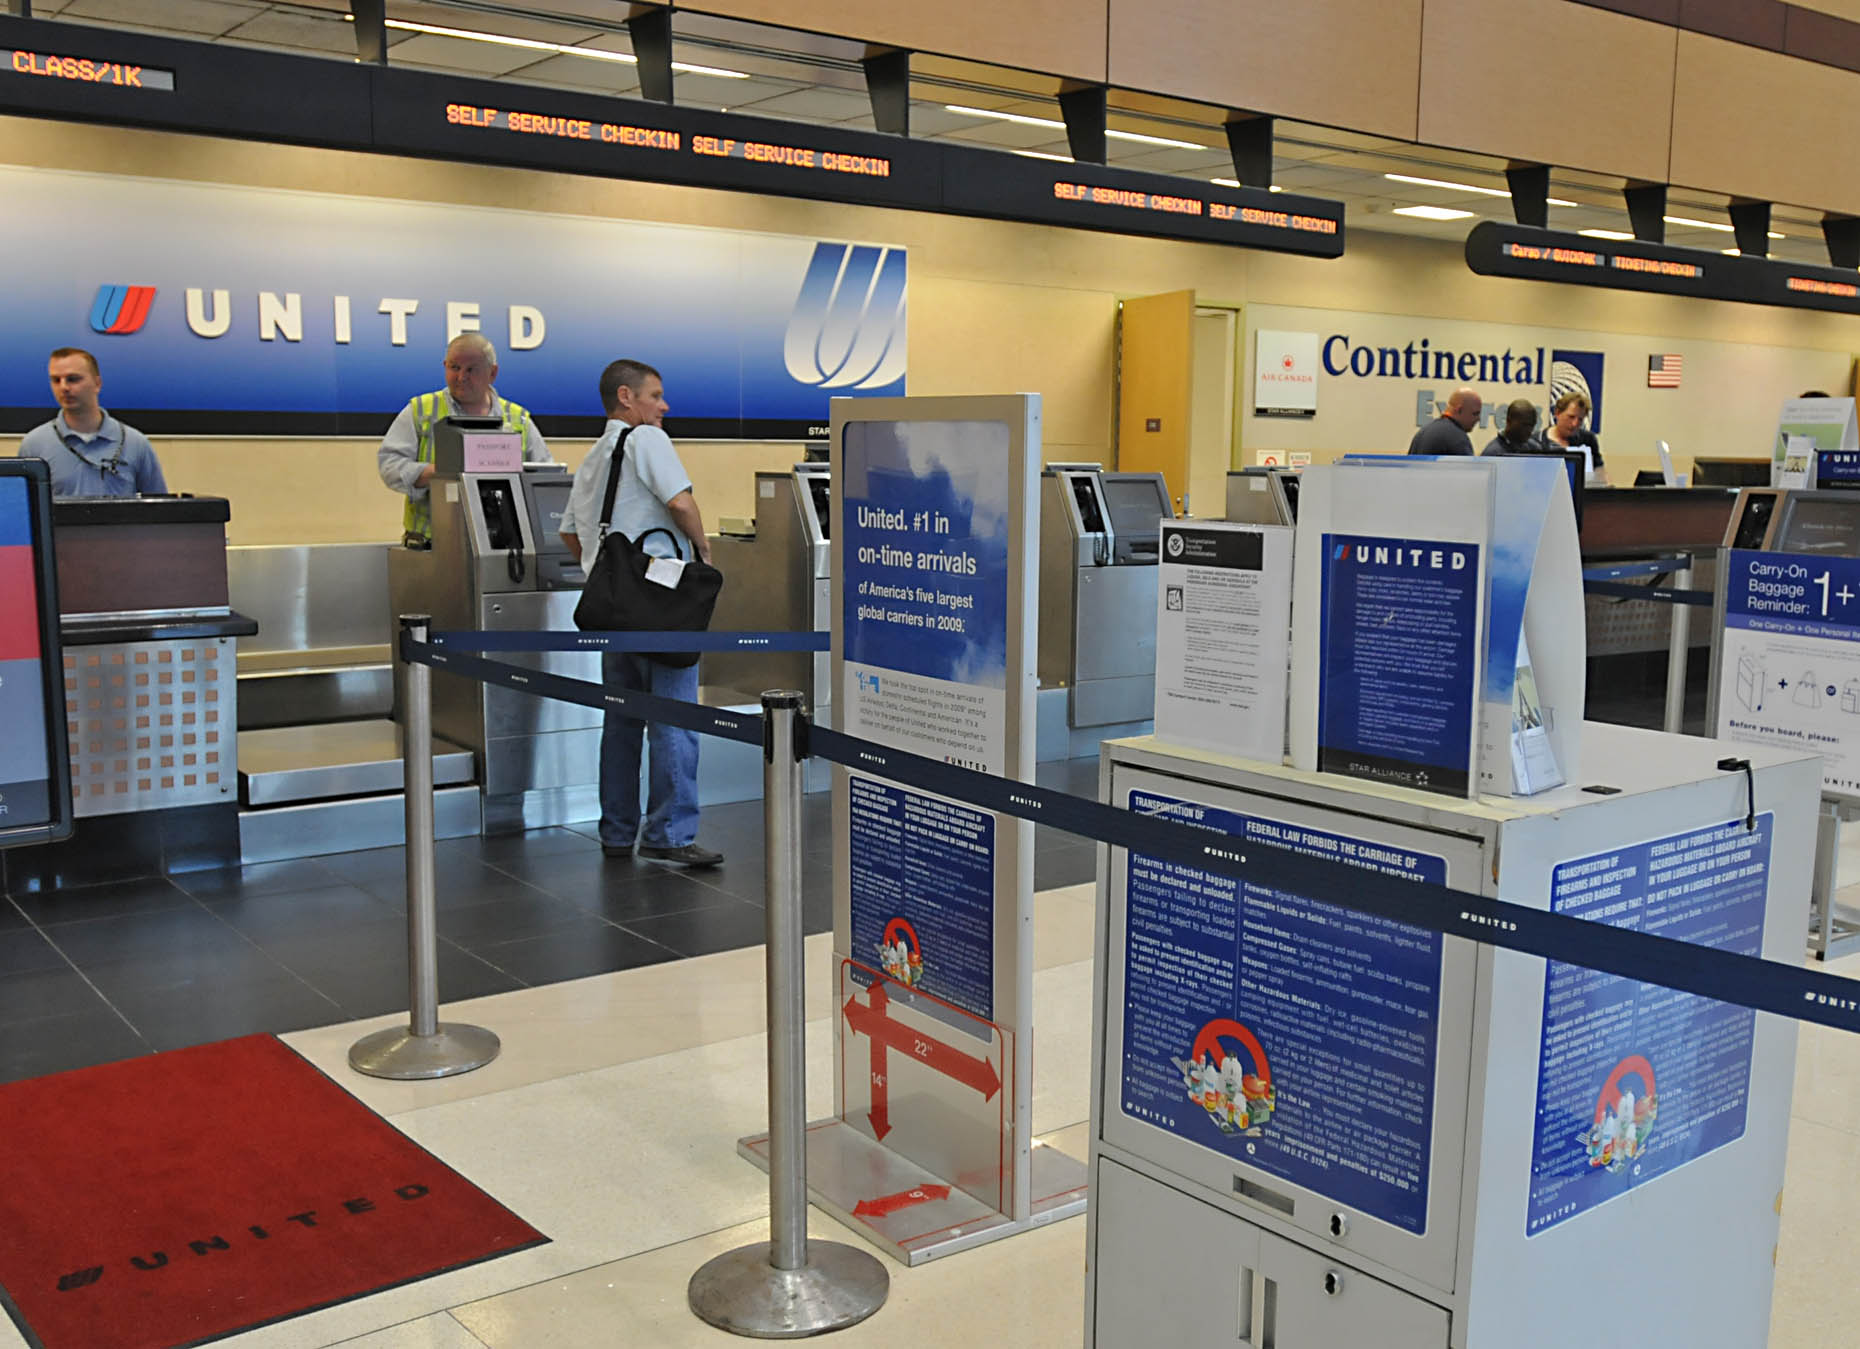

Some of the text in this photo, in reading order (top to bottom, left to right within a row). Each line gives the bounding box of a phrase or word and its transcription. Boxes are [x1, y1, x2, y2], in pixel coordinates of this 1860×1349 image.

[12, 50, 142, 87] CLASS/1K
[446, 104, 681, 150] SELF SERVICE CHECKIN
[692, 135, 890, 176] SELF SERVICE CHECKIN
[1054, 182, 1202, 215] SELF SERVICE CHECKIN
[1241, 208, 1287, 227] SERVICE
[1292, 215, 1337, 234] CHECKIN
[185, 288, 546, 350] UNITED
[1322, 335, 1544, 384] Continental
[1261, 373, 1312, 383] AIR CANADA
[808, 426, 830, 436] STAR
[858, 505, 949, 534] United. #1 in
[858, 544, 976, 574] on-time arrivals
[1356, 545, 1466, 570] UNITED
[1749, 560, 1807, 579] Carry-On
[858, 581, 973, 609] of America's five largest
[1748, 578, 1804, 597] Baggage
[858, 604, 884, 620] global
[886, 610, 923, 626] carriers
[925, 613, 935, 628] in
[1747, 595, 1810, 614] Reminder:
[1749, 619, 1762, 628] One
[1804, 625, 1819, 634] One
[1820, 626, 1850, 638] Personal
[1759, 725, 1774, 733] you
[865, 753, 885, 765] UNITED
[951, 757, 987, 772] UNITED
[1350, 763, 1411, 781] STAR ALLIANCE
[1016, 797, 1041, 808] UNITED
[1135, 795, 1204, 820] TRANSPORTATION OF
[1246, 821, 1280, 838] FEDERAL
[1283, 829, 1300, 842] LAW
[1302, 833, 1337, 851] FORBIDS
[1340, 842, 1356, 855] THE
[1358, 845, 1402, 866] CARRIAGE
[1405, 856, 1417, 869] OF
[1649, 833, 1761, 871] HAZARDOUS MATERIALS ABOARD AIRCRAFT
[1651, 841, 1675, 856] FEDERAL
[1676, 838, 1688, 850] LAW
[1690, 832, 1712, 847] FORBIDS
[1713, 829, 1723, 841] THE
[1211, 849, 1246, 863] UNITED
[1558, 855, 1619, 880] TRANSPORTATION OF
[1648, 874, 1655, 885] IN
[1656, 870, 1671, 883] YOUR
[1672, 863, 1697, 879] LUGGAGE
[1707, 858, 1714, 869] ON
[1716, 854, 1729, 867] YOUR
[1731, 848, 1750, 863] PERSON
[1133, 853, 1236, 890] Firearms in checked baggage
[1133, 867, 1148, 878] must
[1149, 871, 1158, 881] be
[1159, 873, 1187, 889] declared
[1188, 881, 1201, 892] and
[1556, 866, 1636, 896] FIREARMS AND INSPECTION
[1132, 878, 1235, 915] Passengers failing to declare
[1555, 884, 1621, 911] OF CHECKED BAGGAGE
[1647, 892, 1655, 904] DO
[1656, 889, 1666, 901] NOT
[1668, 885, 1681, 898] PACK
[1683, 883, 1688, 894] IN
[1689, 876, 1712, 892] LUGGAGE
[1721, 869, 1737, 883] CARRY
[1132, 891, 1235, 928] firearms or transporting loaded
[1471, 913, 1516, 931] UNITED
[1132, 904, 1234, 941] firearms are subject to substantial
[1241, 977, 1256, 990] Other
[1258, 983, 1289, 1000] Hazardous
[1818, 994, 1860, 1010] UNIT
[914, 1040, 932, 1056] 22"
[1135, 1104, 1174, 1127] UNITED
[1540, 1202, 1576, 1224] UNITED
[131, 1184, 429, 1270] UNITED
